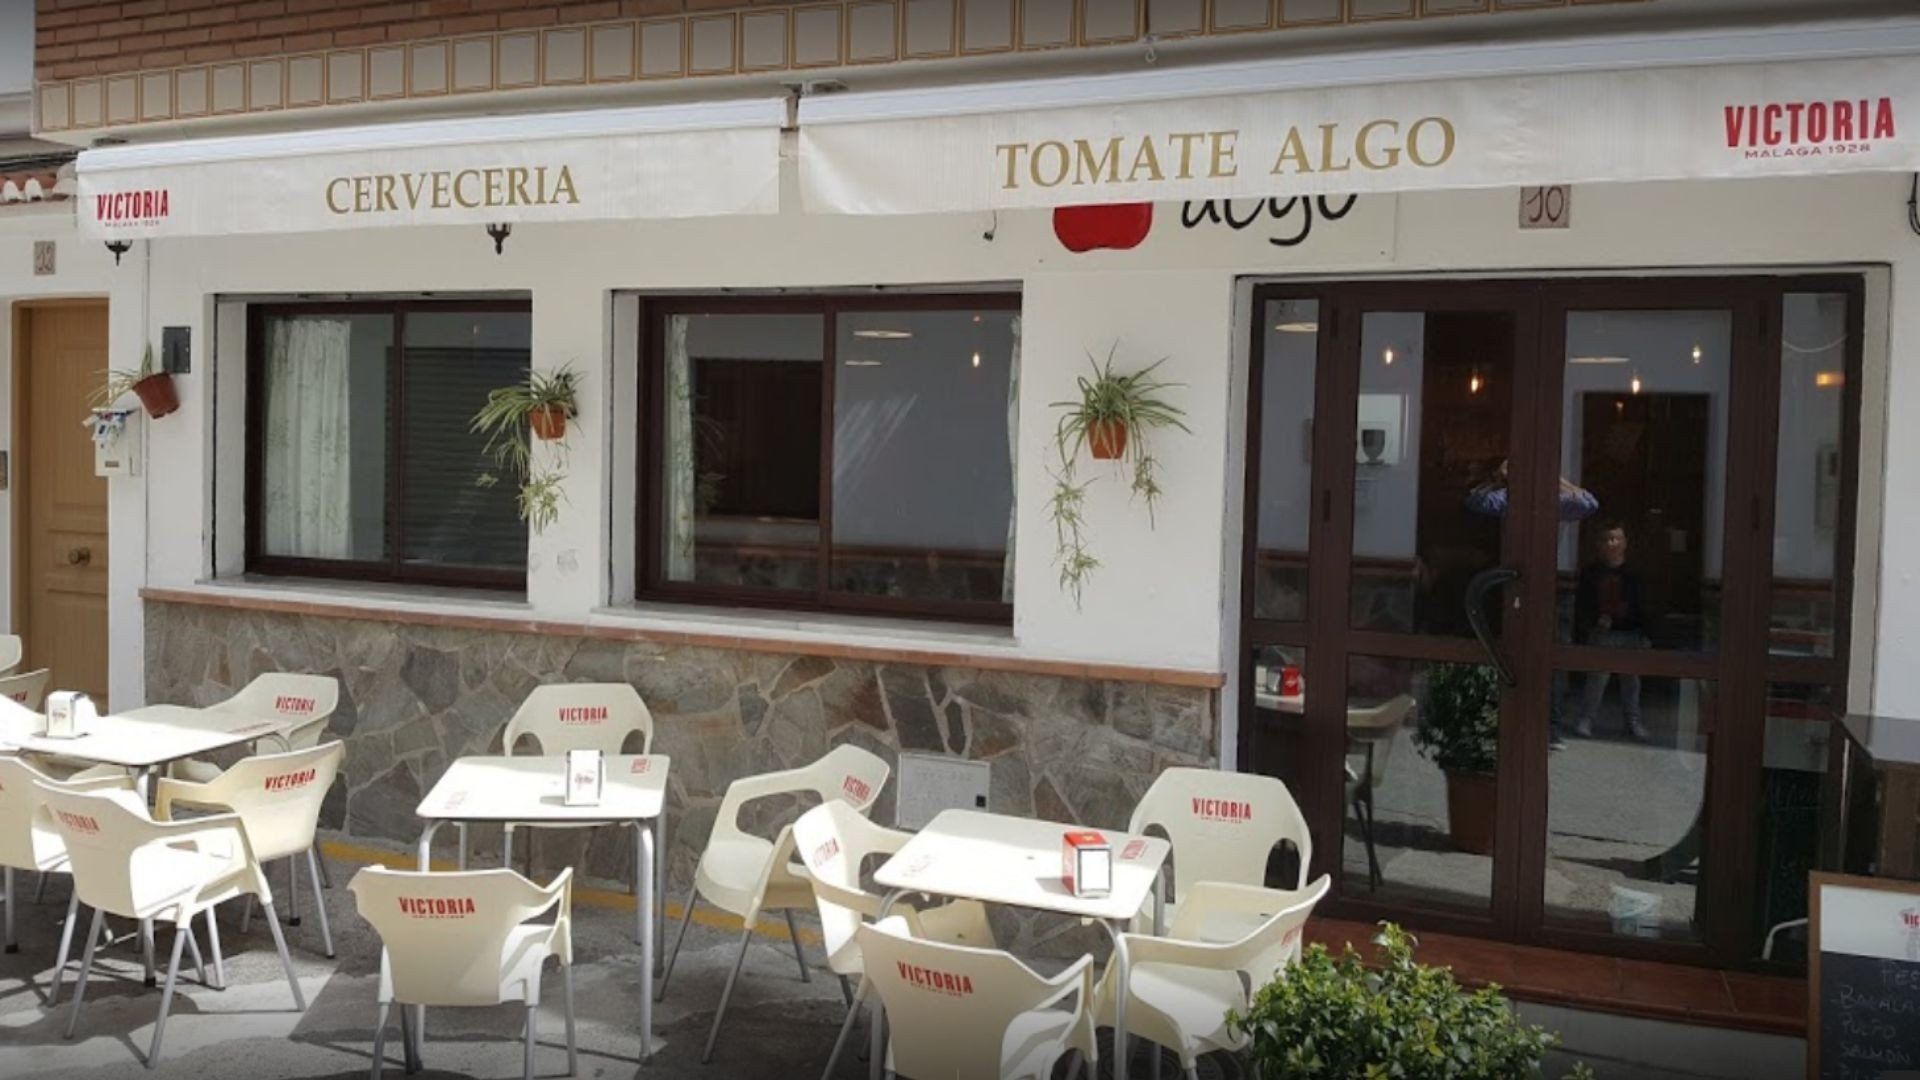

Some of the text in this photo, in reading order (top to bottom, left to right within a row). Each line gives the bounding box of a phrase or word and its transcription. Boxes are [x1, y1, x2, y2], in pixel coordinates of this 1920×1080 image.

[1724, 97, 1895, 147] VICTORIA
[995, 116, 1456, 189] TOMATE ALGO
[1745, 144, 1871, 159] MALAGA 1928
[325, 165, 580, 214] CERVECERIA
[97, 189, 168, 220] VICTORIA
[1526, 186, 1564, 223] 10
[276, 696, 315, 712] VICTORIA
[559, 707, 608, 722] VICTORIA
[265, 768, 316, 790] VICTORIA
[1192, 797, 1252, 820] VICTORIA
[398, 896, 476, 915] VICTORIA
[896, 960, 973, 995] VICTORIA
